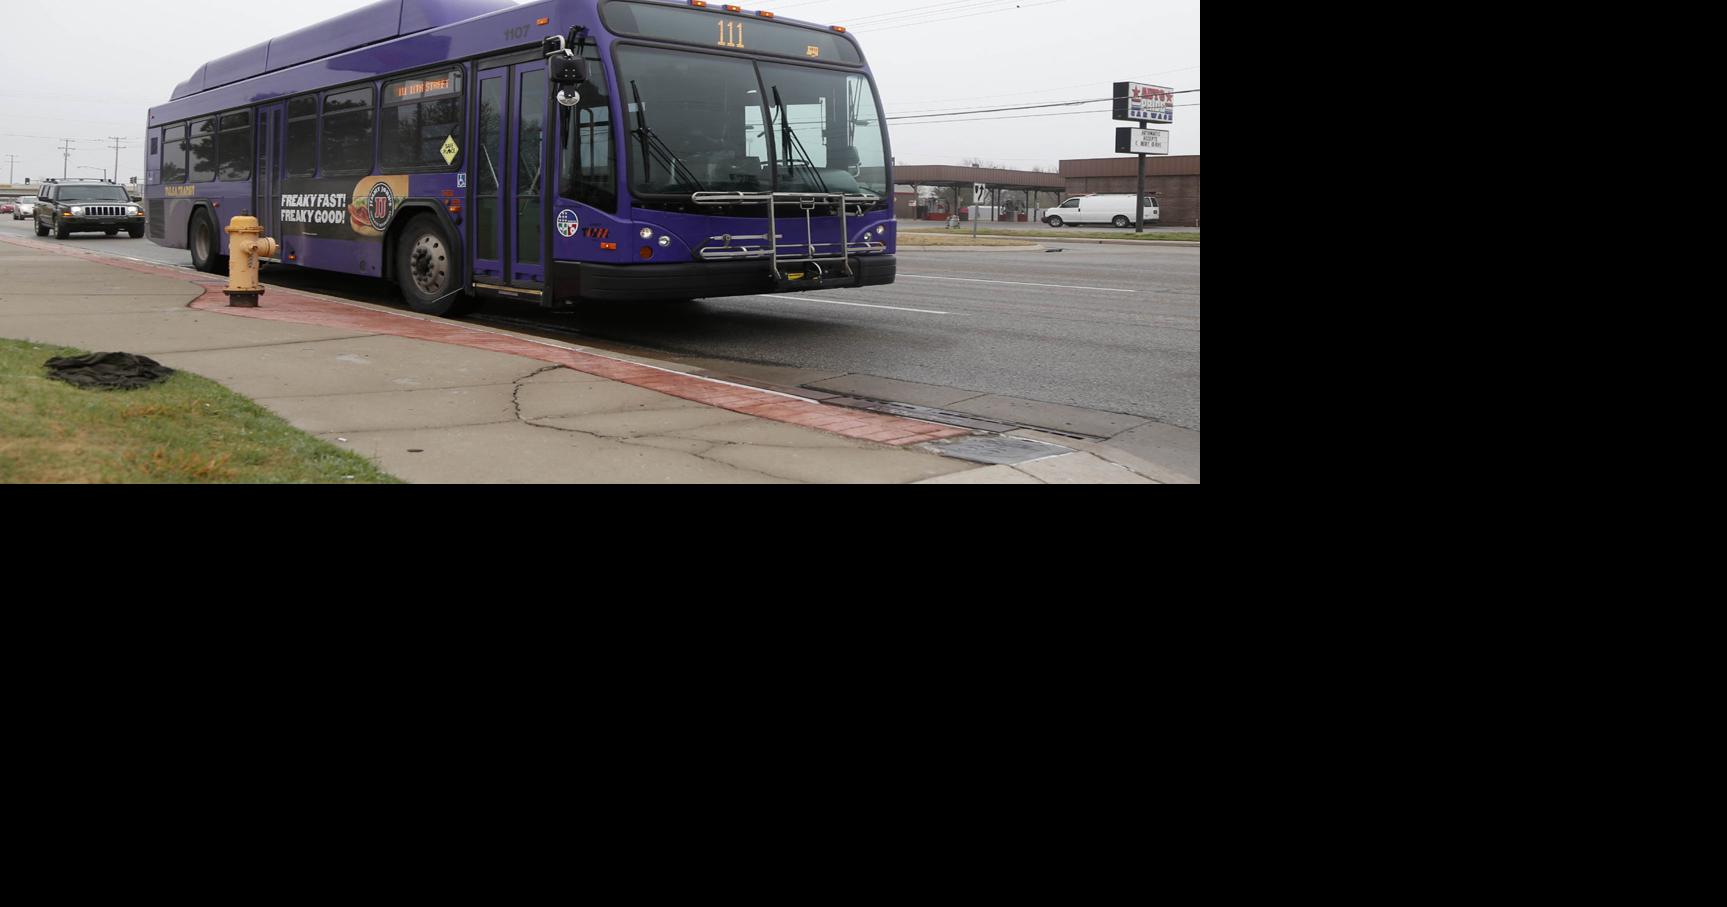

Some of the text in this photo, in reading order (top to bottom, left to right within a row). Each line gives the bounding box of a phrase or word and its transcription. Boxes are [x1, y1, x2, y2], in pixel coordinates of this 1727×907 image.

[503, 24, 530, 40] 1107
[717, 19, 744, 48] 111
[1130, 110, 1148, 118] CAR
[281, 193, 347, 208] FREAKY FAST!
[280, 209, 346, 224] FREAKY GOOD!
